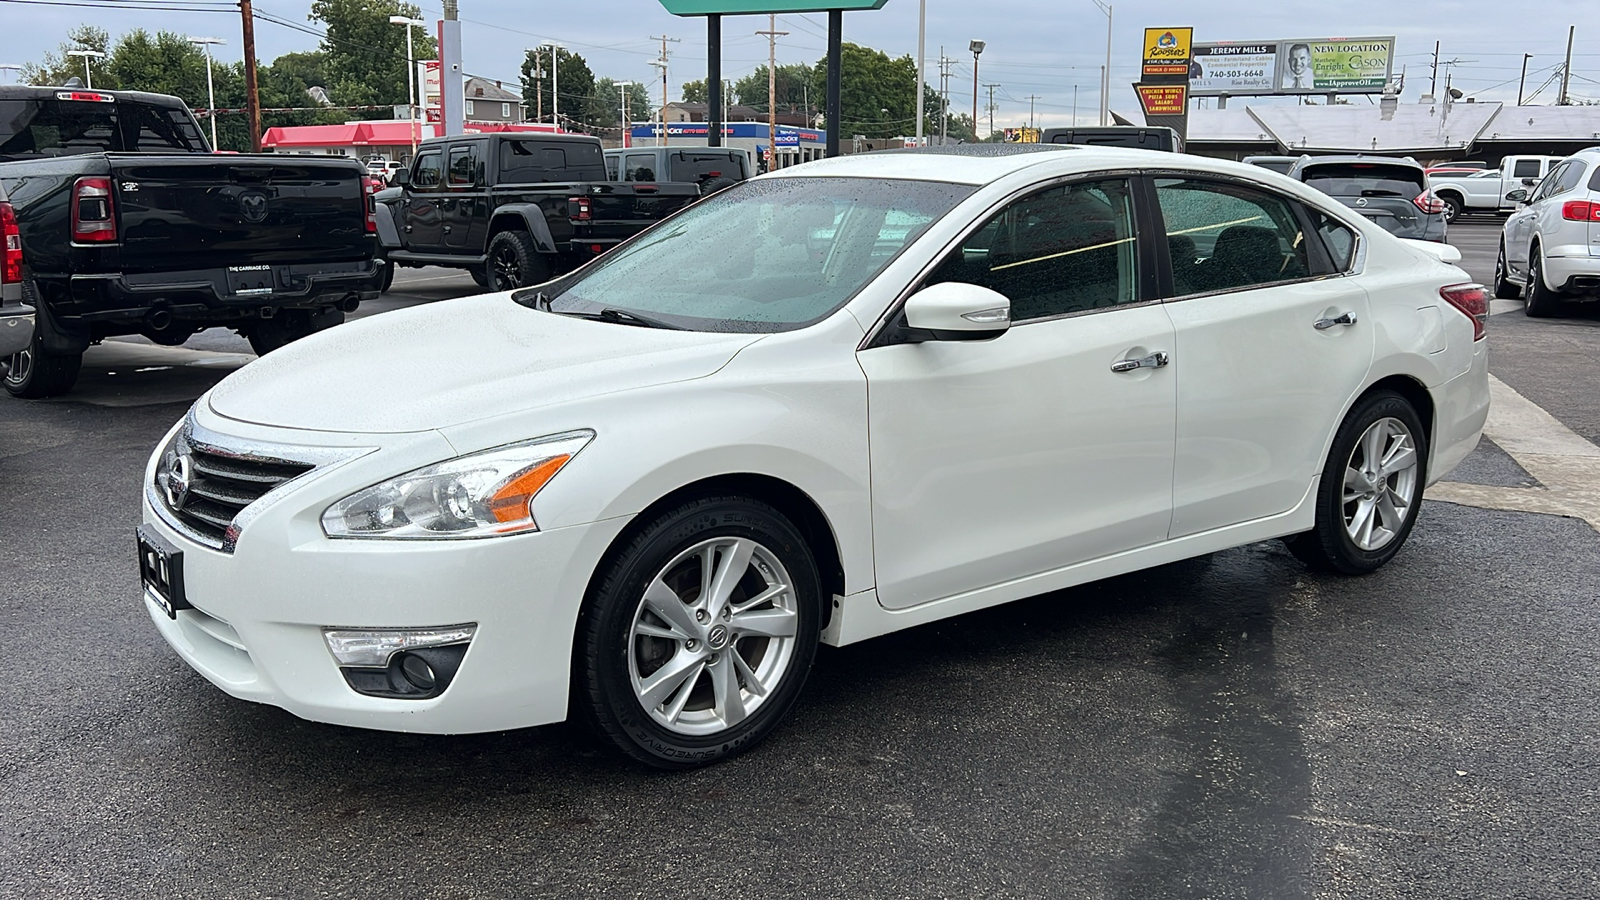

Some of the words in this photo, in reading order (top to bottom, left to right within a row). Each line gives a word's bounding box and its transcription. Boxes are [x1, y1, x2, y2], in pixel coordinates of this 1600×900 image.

[1149, 46, 1185, 58] Roosters
[1337, 44, 1387, 52] LOCATION
[1316, 63, 1344, 71] Enright
[1244, 78, 1260, 86] Realty
[636, 731, 717, 759] SUREDRIVE
